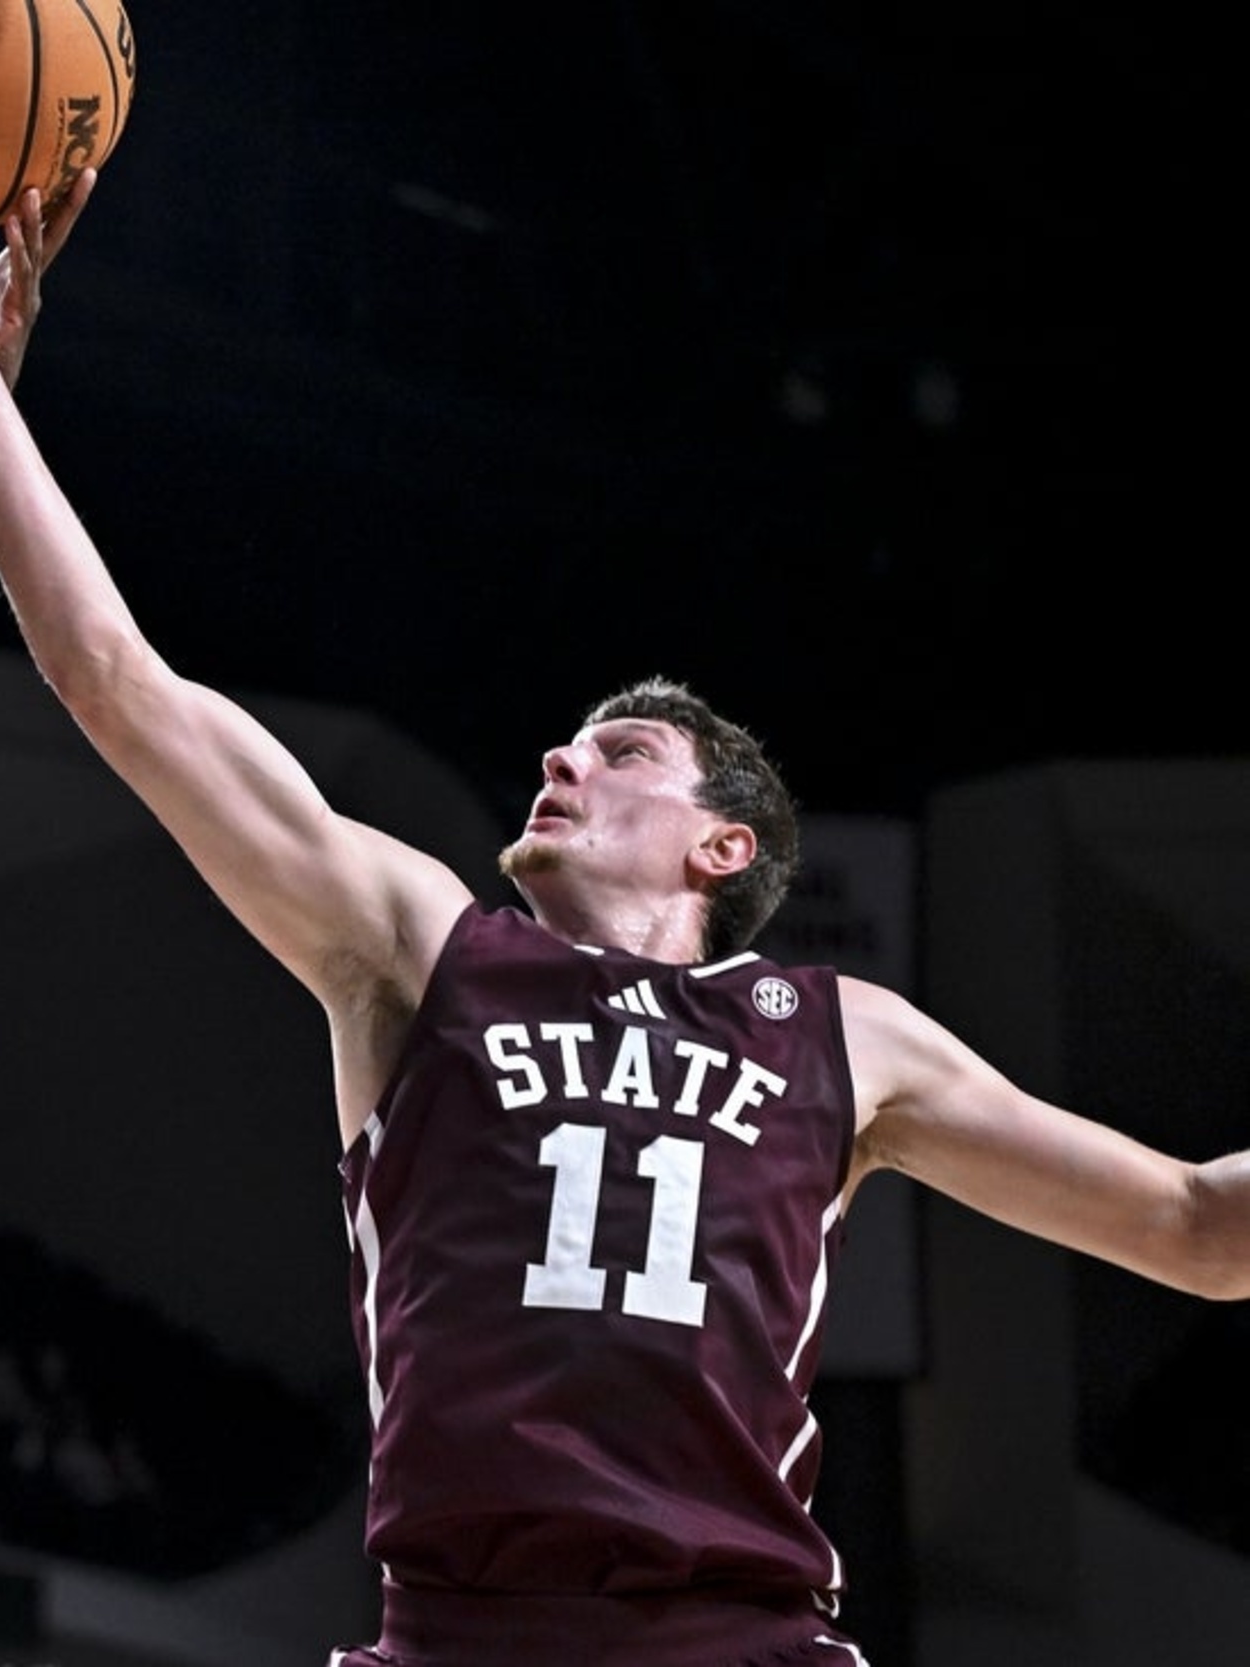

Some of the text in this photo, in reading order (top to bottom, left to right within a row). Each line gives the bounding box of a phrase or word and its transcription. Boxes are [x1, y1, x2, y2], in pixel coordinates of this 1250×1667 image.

[41, 95, 100, 208] NC
[754, 979, 796, 1018] SEC
[483, 1023, 788, 1146] STATE
[522, 1122, 707, 1328] 11
